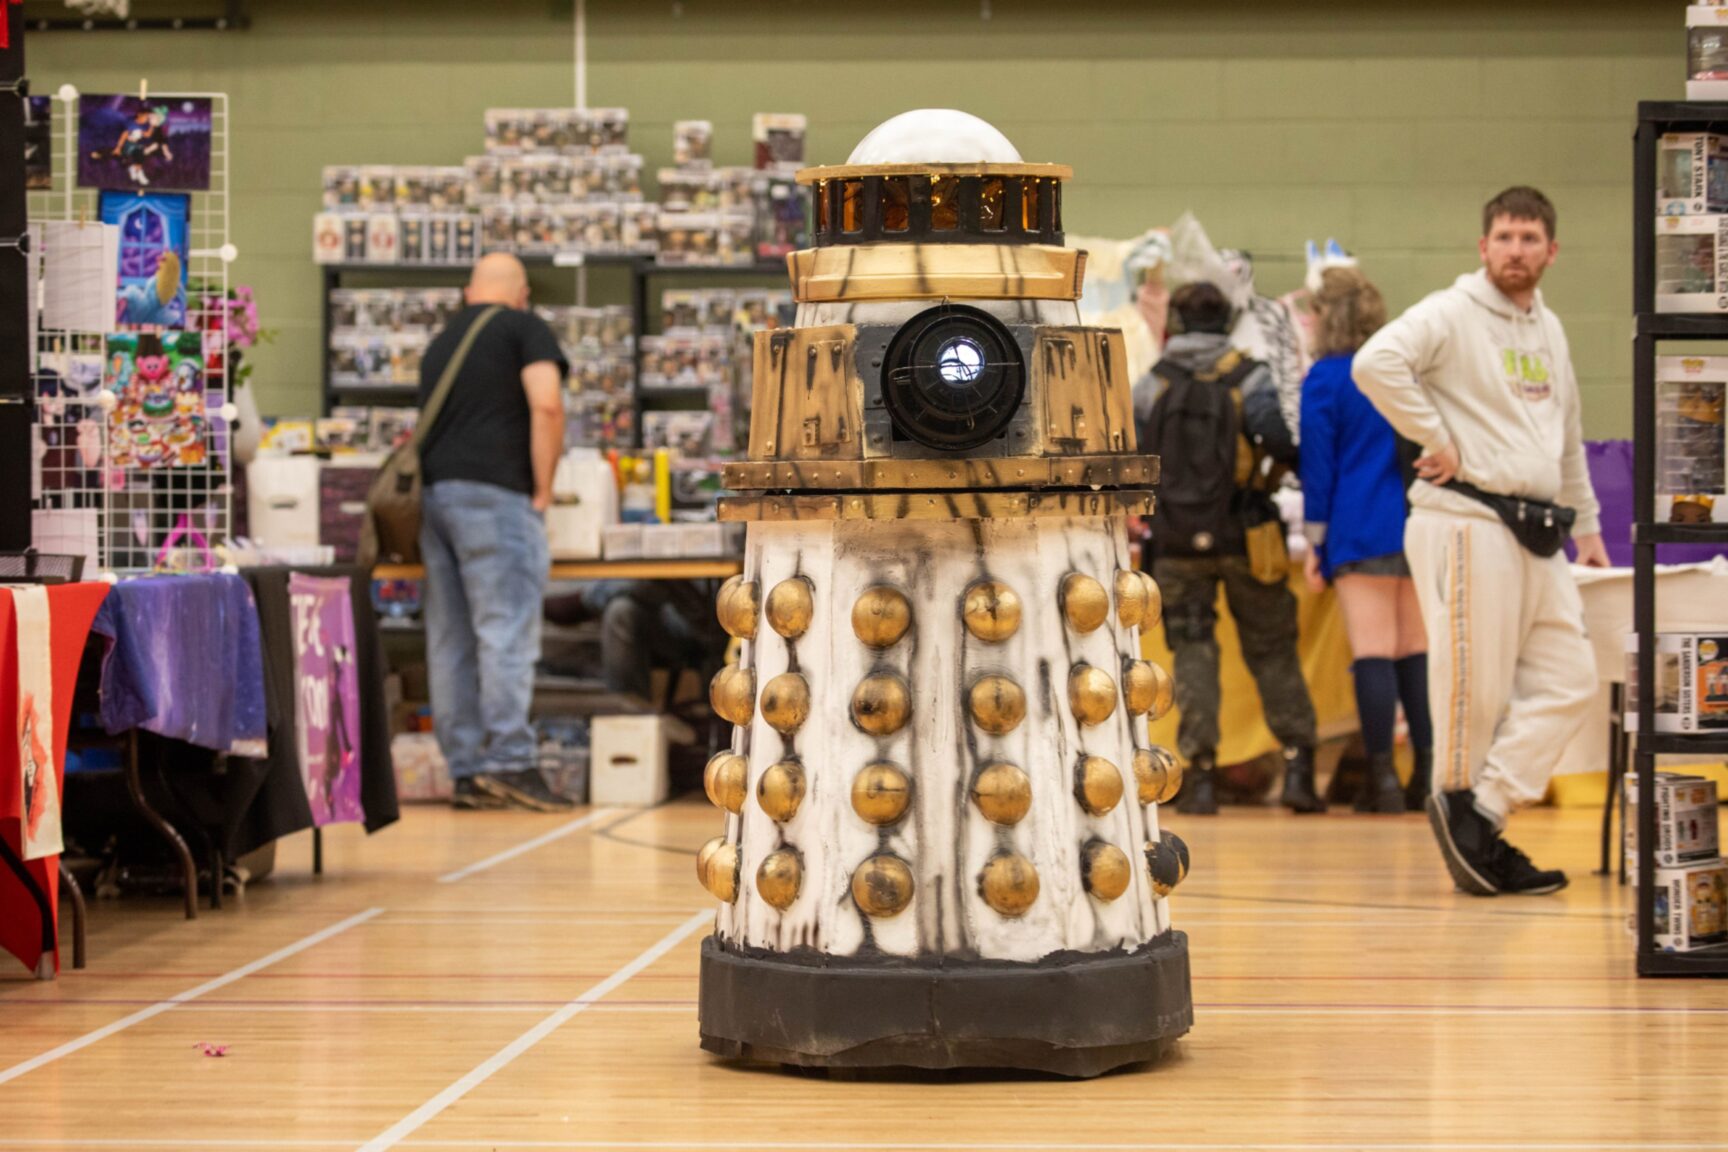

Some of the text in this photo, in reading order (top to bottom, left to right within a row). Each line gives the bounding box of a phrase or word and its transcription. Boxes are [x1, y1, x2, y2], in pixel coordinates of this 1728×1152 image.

[1695, 136, 1704, 198] TONY STARK
[1682, 637, 1692, 714] THE SANDERSON SISTERS
[1662, 787, 1671, 821] FIGHTING
[1674, 913, 1682, 935] TWINS
